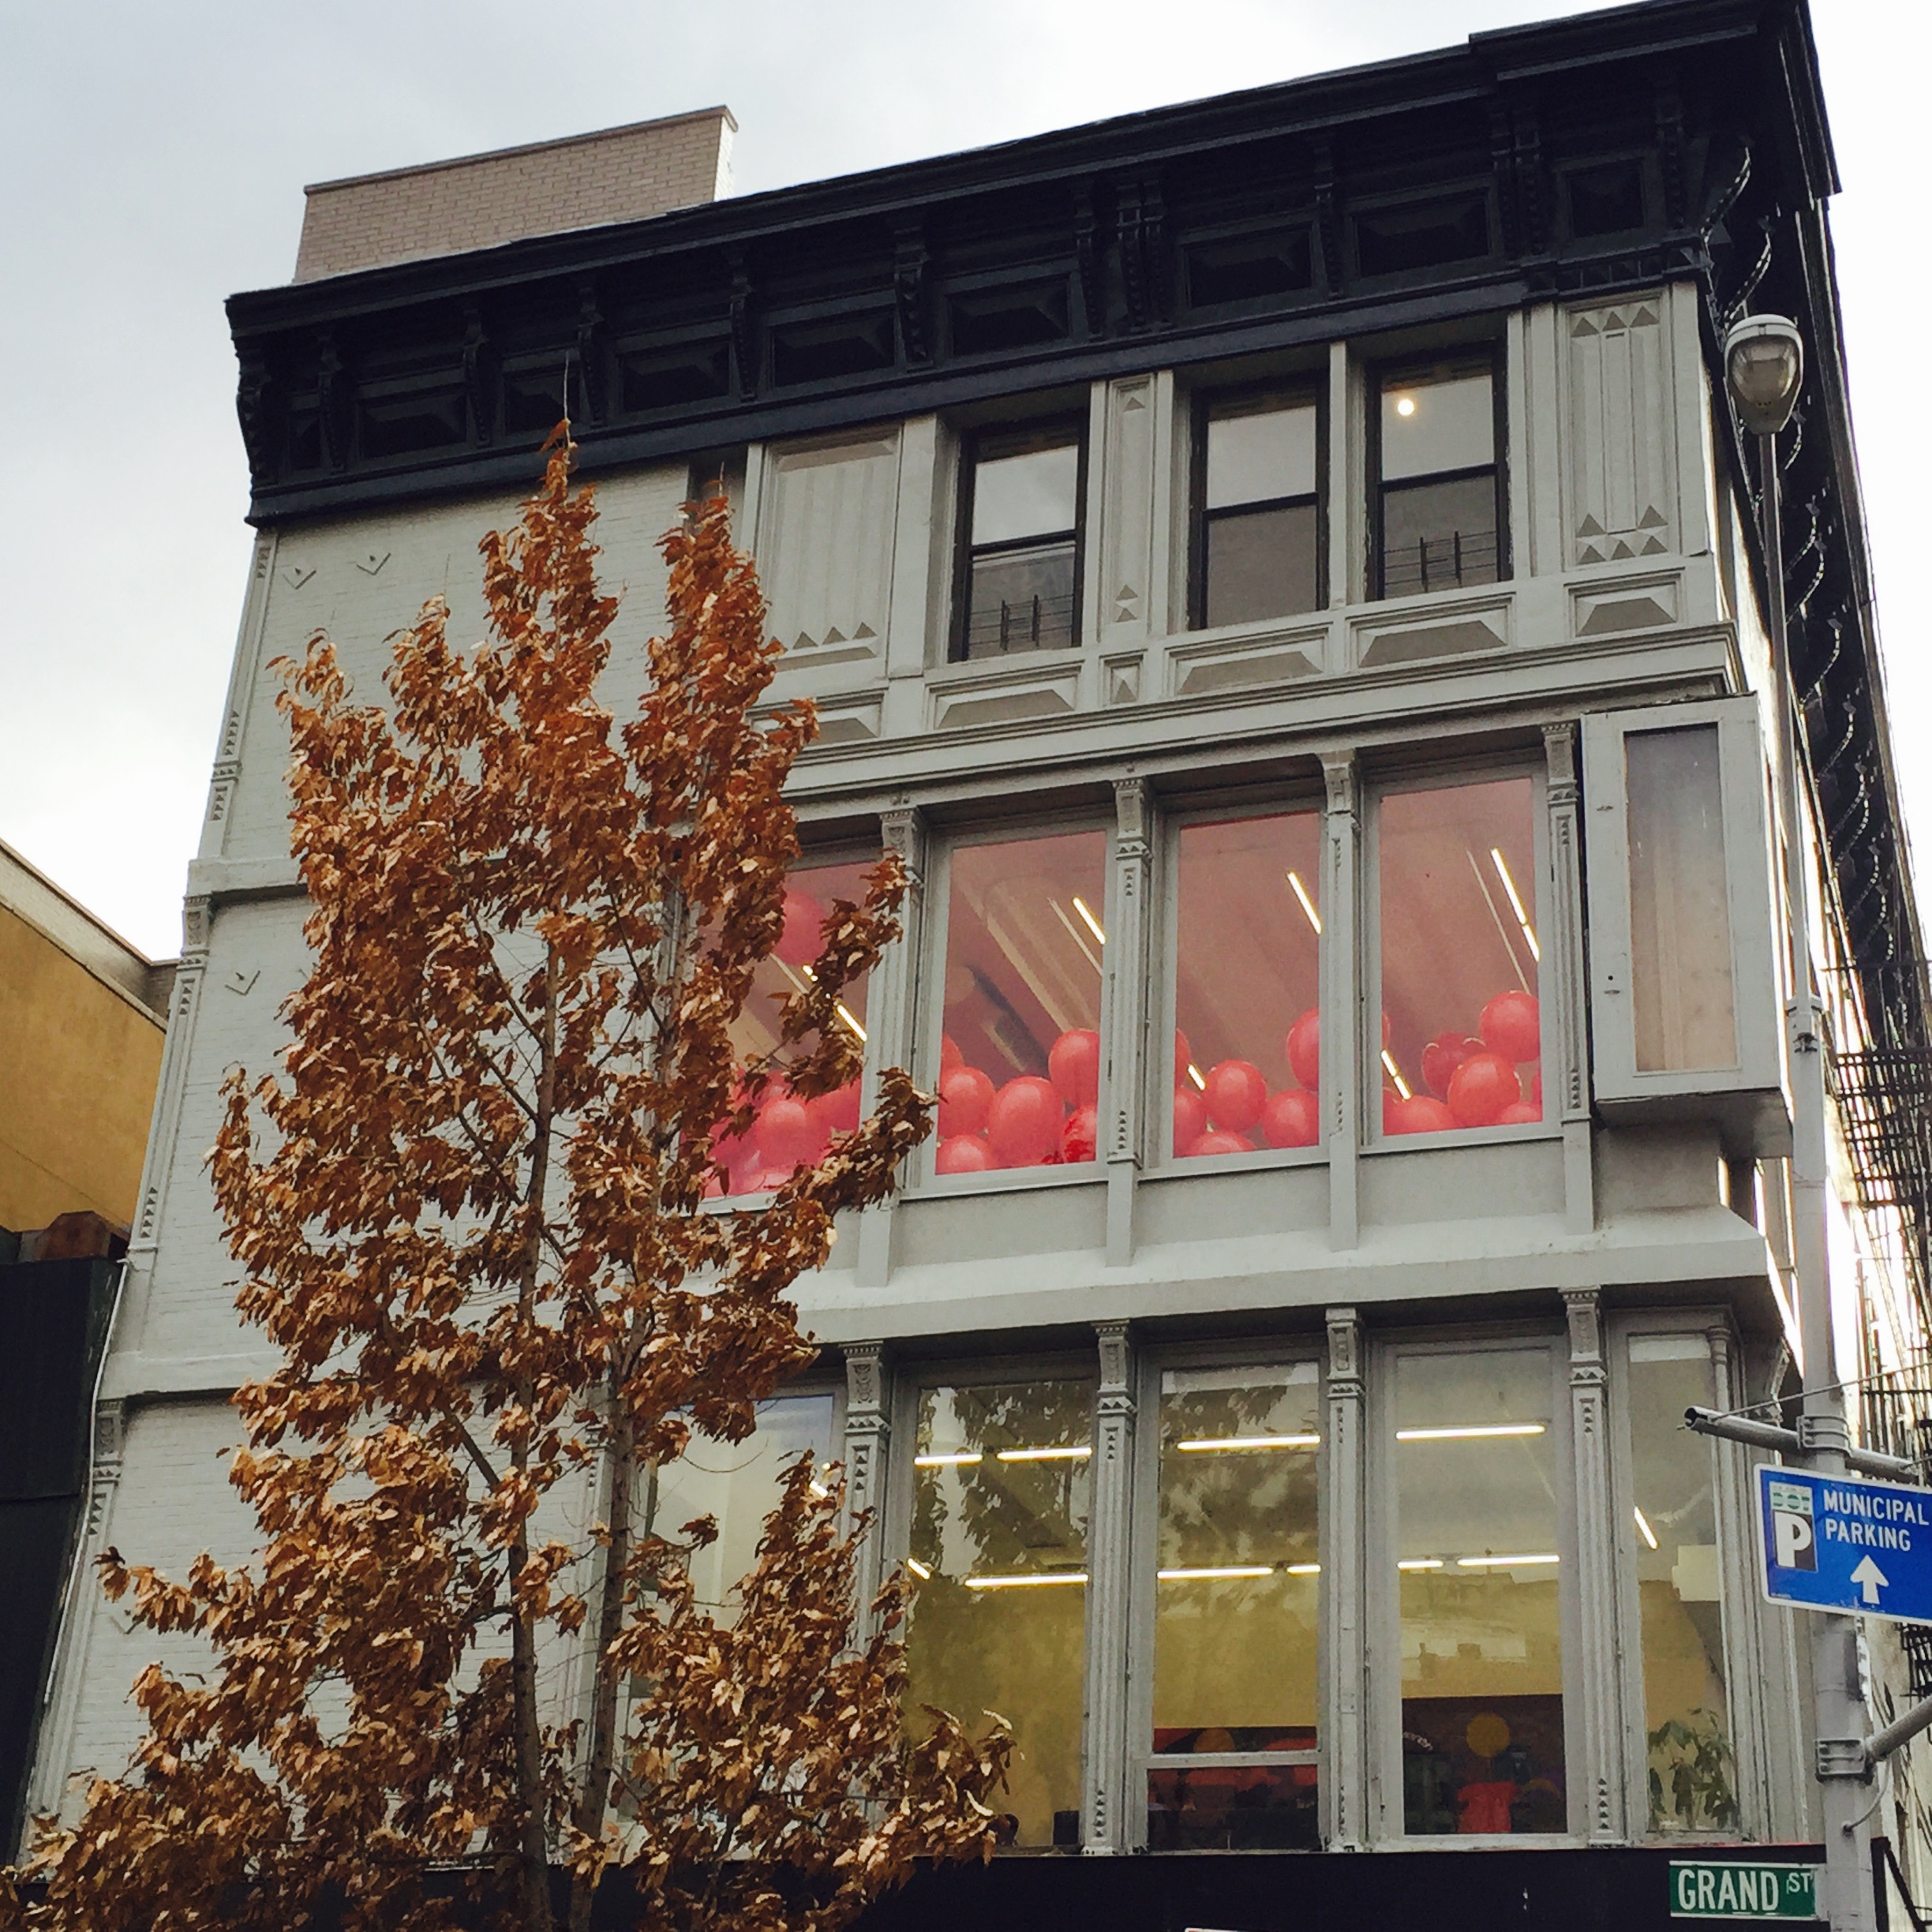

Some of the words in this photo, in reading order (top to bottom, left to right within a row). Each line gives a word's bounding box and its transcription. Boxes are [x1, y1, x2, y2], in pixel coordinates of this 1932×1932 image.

[1823, 1489, 1930, 1526] MUNICIPAL
[1774, 1511, 1812, 1568] P
[1825, 1518, 1911, 1552] PARKING
[1678, 1869, 1779, 1911] GRAND
[1787, 1872, 1813, 1893] ST
